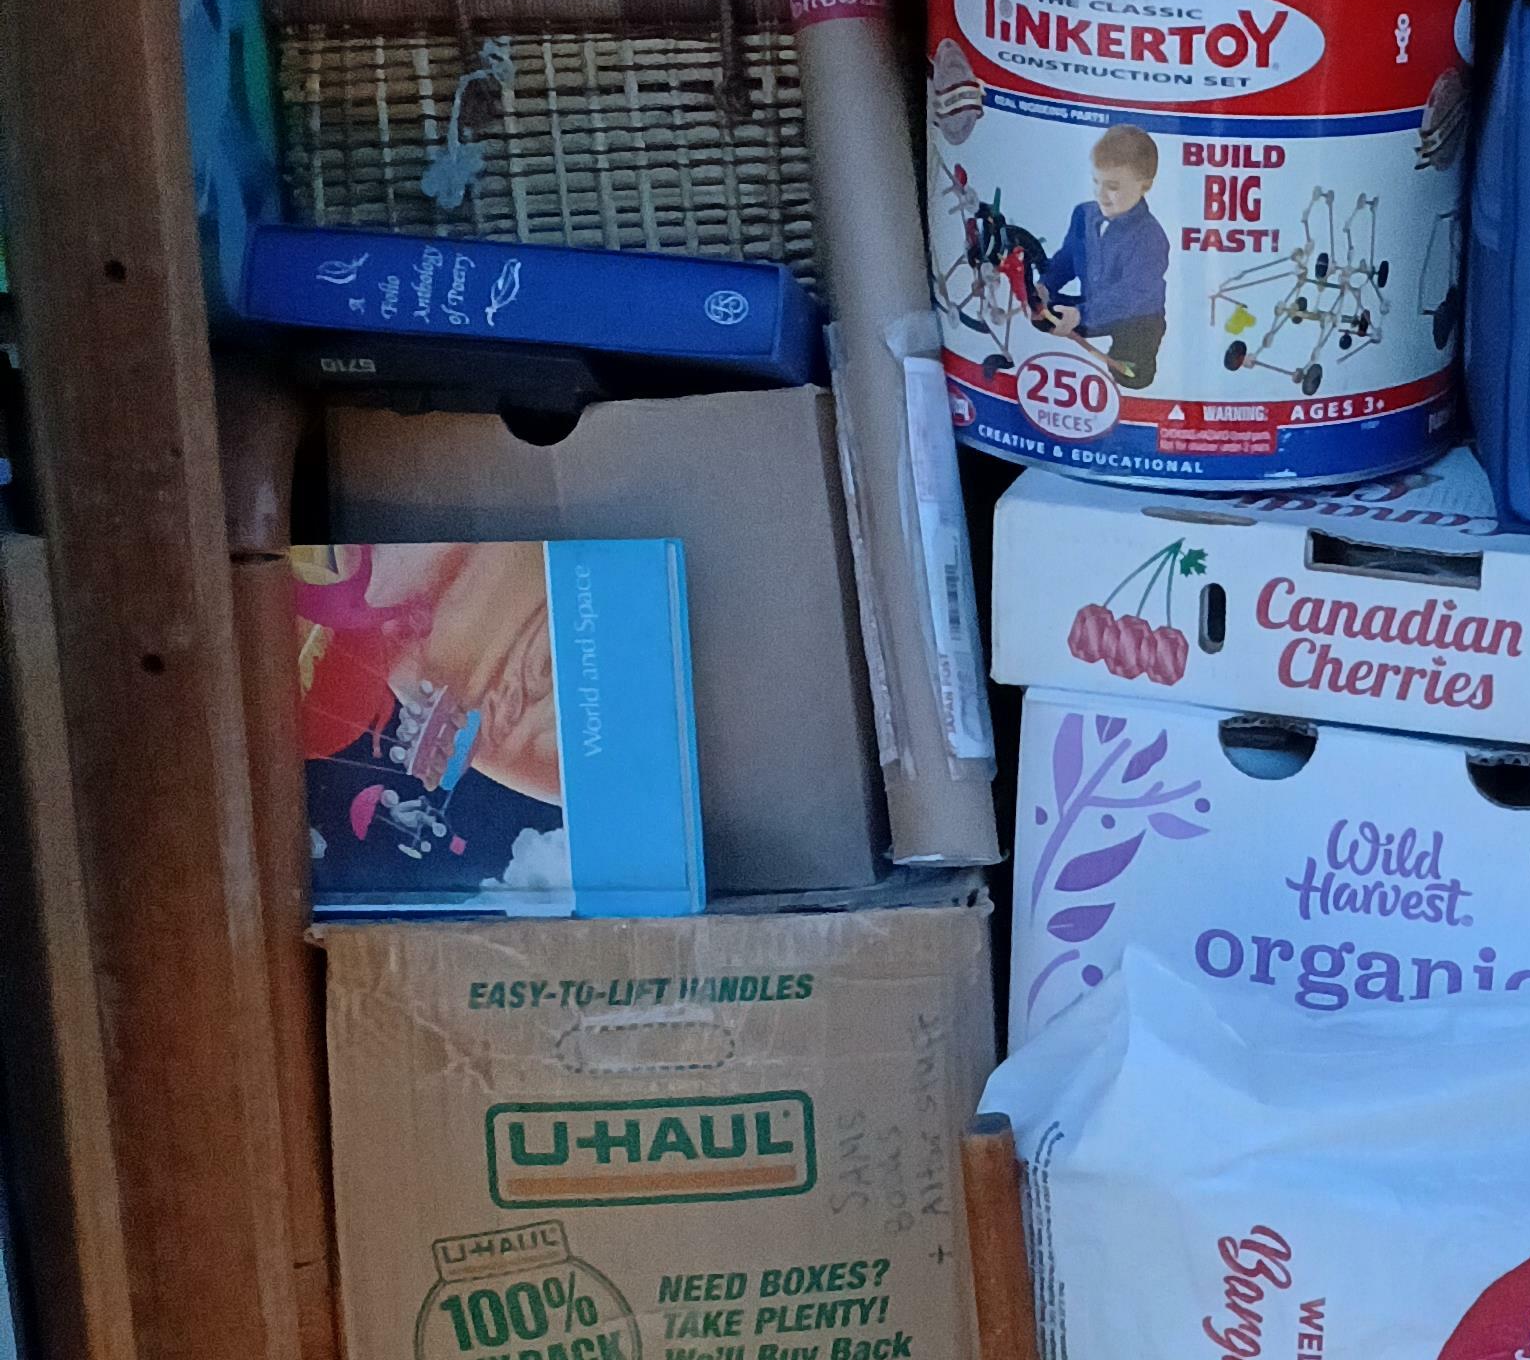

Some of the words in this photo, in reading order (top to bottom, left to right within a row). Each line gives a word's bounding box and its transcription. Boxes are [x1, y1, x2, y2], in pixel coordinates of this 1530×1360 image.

[997, 49, 1194, 87] CONSTRUCTION
[1203, 75, 1252, 90] SET
[1182, 142, 1286, 170] BUILD
[1203, 174, 1263, 222] BIG
[1181, 228, 1280, 253] FAST!
[1025, 362, 1109, 414] 250
[1290, 399, 1354, 422] AGES
[1036, 408, 1095, 435] PIECES
[977, 423, 1048, 459] CREATIVE
[1071, 445, 1205, 476] EDUCATIONAL
[572, 564, 600, 634] Space
[1254, 575, 1525, 658] Canadian
[578, 637, 600, 681] and
[1277, 636, 1496, 711] Cherries
[578, 687, 602, 757] World
[1325, 817, 1446, 881] Wild
[468, 976, 671, 1010] EASY-TO-LIFT
[679, 971, 815, 1004] HANDLES
[508, 1110, 794, 1167] U-HAUL
[440, 1228, 561, 1266] U-HAUL
[657, 1273, 748, 1305] NEED
[760, 1258, 892, 1300] BOXES?
[440, 1272, 600, 1353] 100%
[662, 1309, 743, 1341] TAKE
[754, 1296, 891, 1337] PLENTY!
